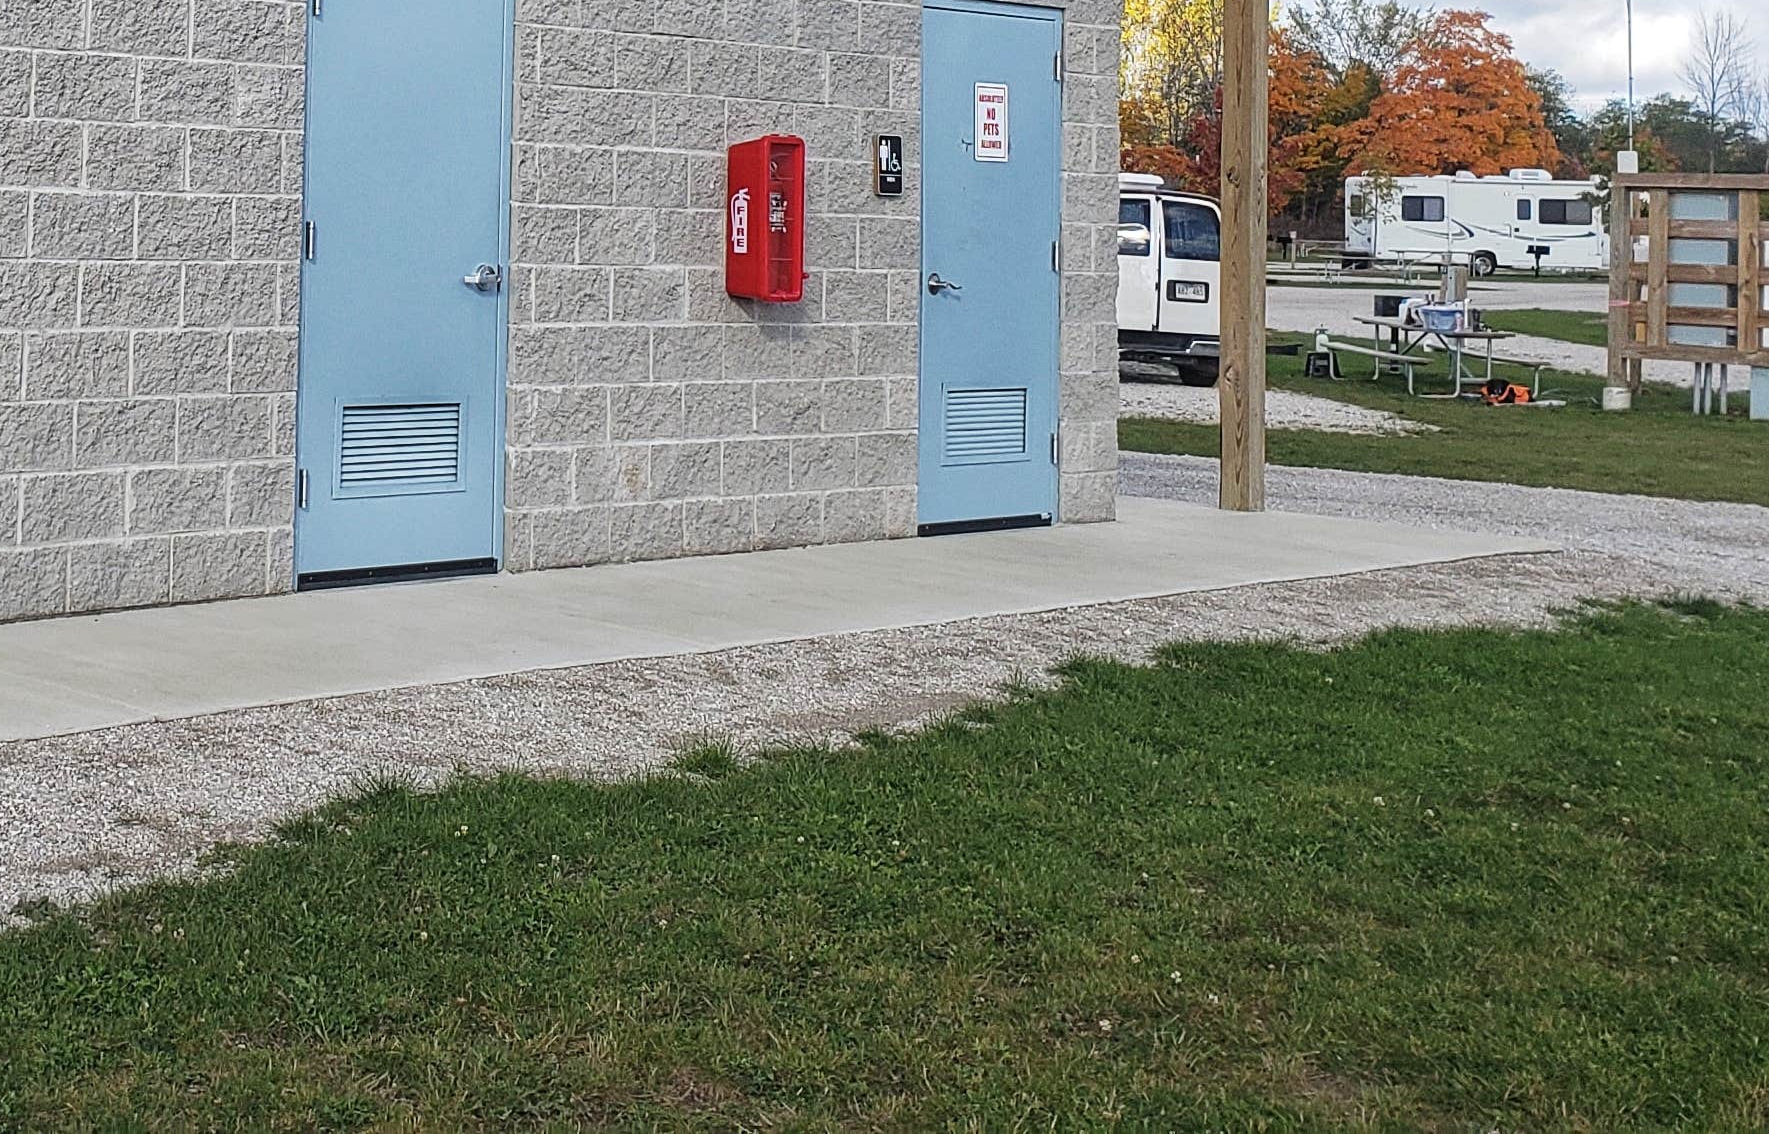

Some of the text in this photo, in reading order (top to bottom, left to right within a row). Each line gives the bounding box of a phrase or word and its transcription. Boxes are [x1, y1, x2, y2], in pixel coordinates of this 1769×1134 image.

[986, 107, 996, 120] NO
[983, 122, 1000, 136] PETS
[736, 206, 745, 247] FIRE
